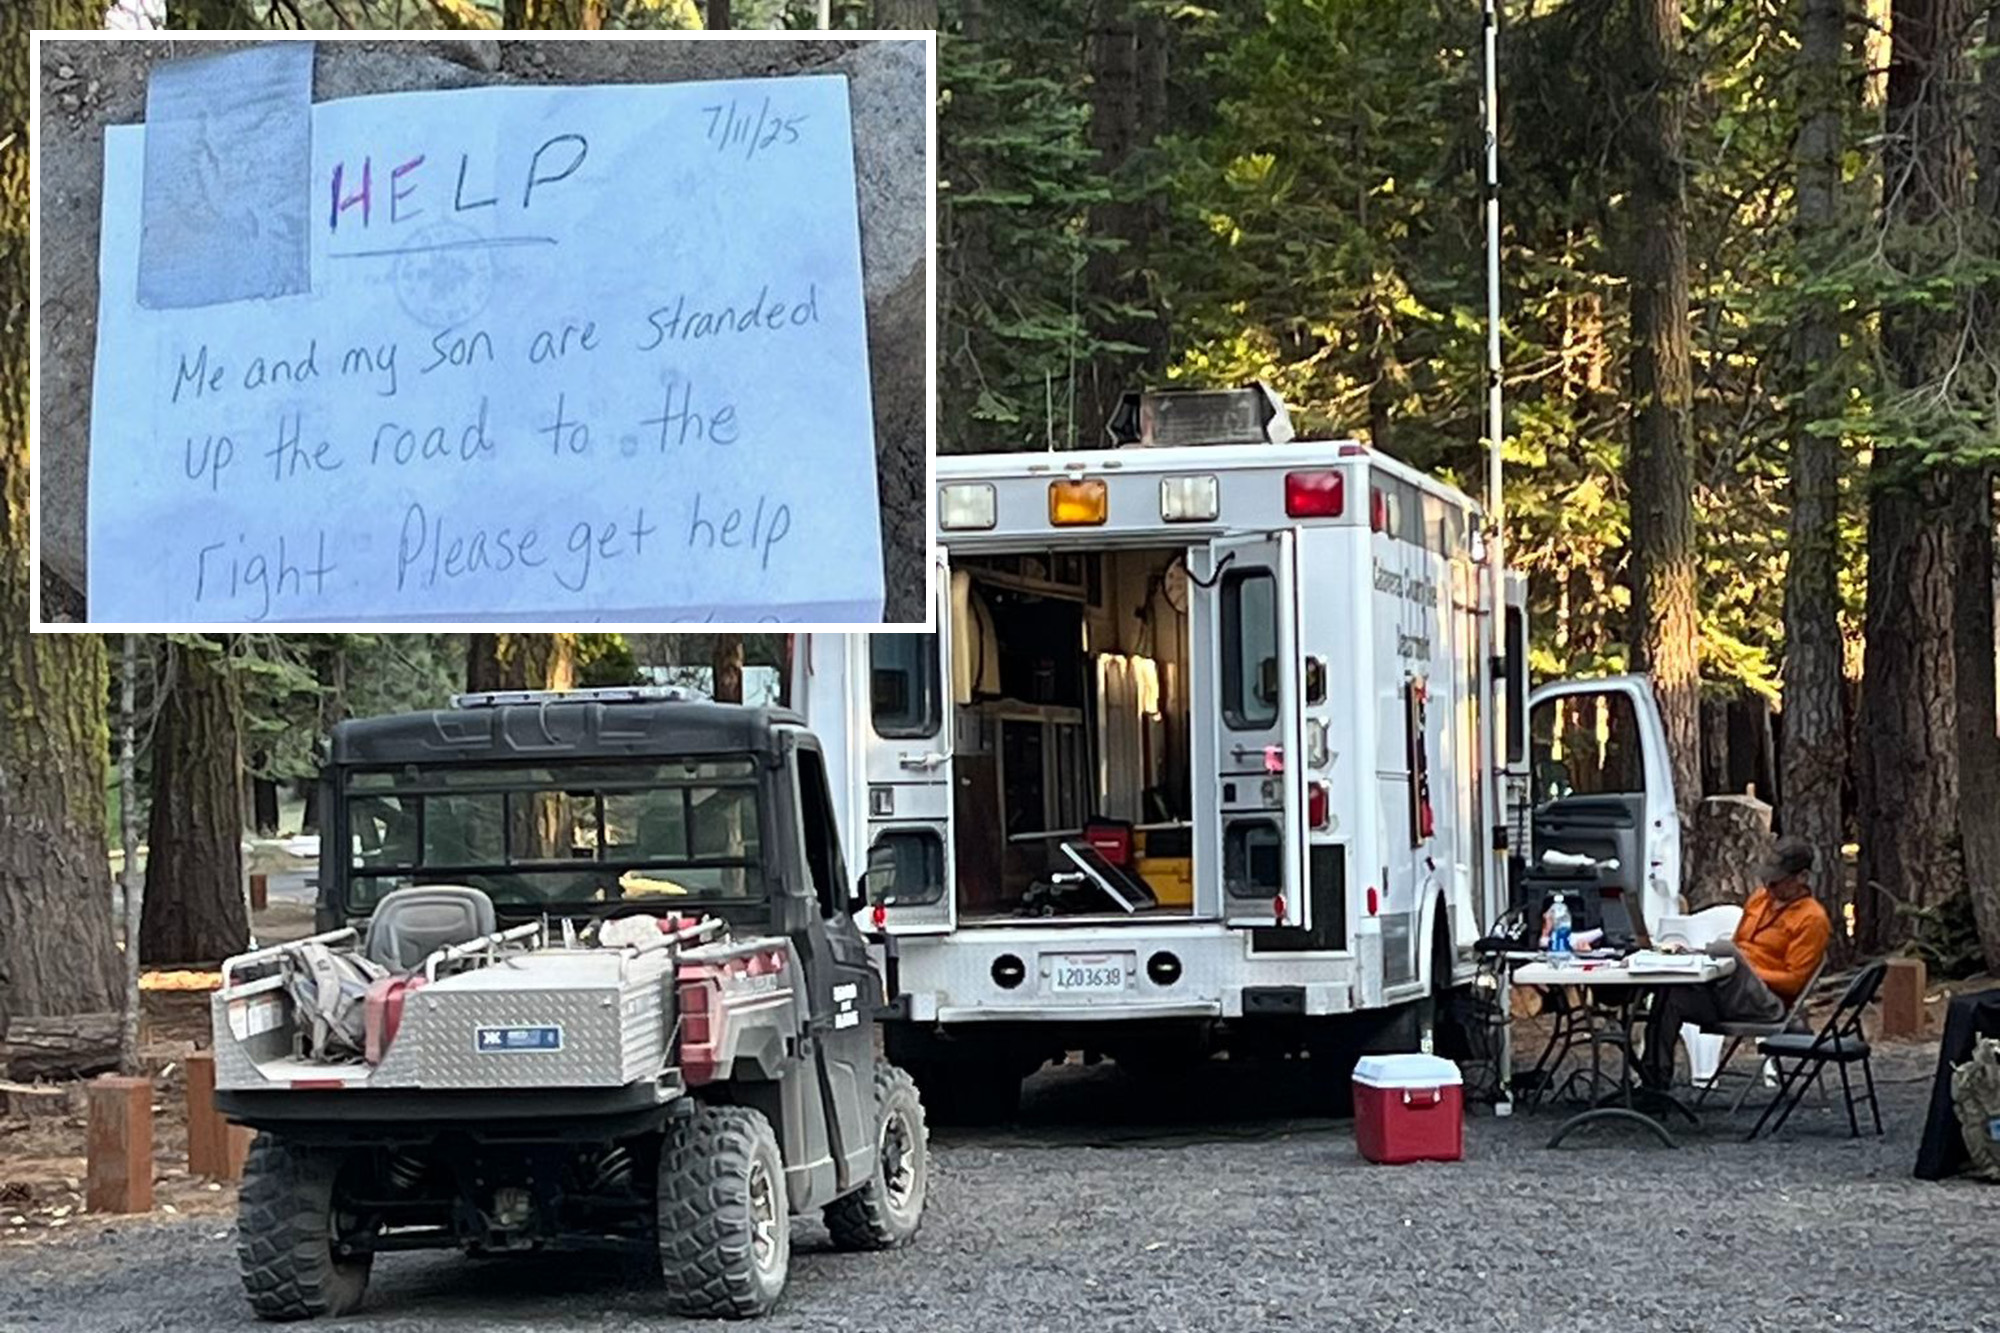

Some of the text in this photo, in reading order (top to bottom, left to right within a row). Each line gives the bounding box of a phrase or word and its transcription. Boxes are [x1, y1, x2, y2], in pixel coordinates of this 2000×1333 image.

[701, 97, 809, 160] 7/11/25
[329, 133, 588, 234] HELP
[172, 283, 820, 404] Me and my son are stranded
[185, 380, 740, 492] up the road to the
[397, 501, 549, 592] Please
[553, 507, 657, 592] get
[688, 492, 792, 571] help
